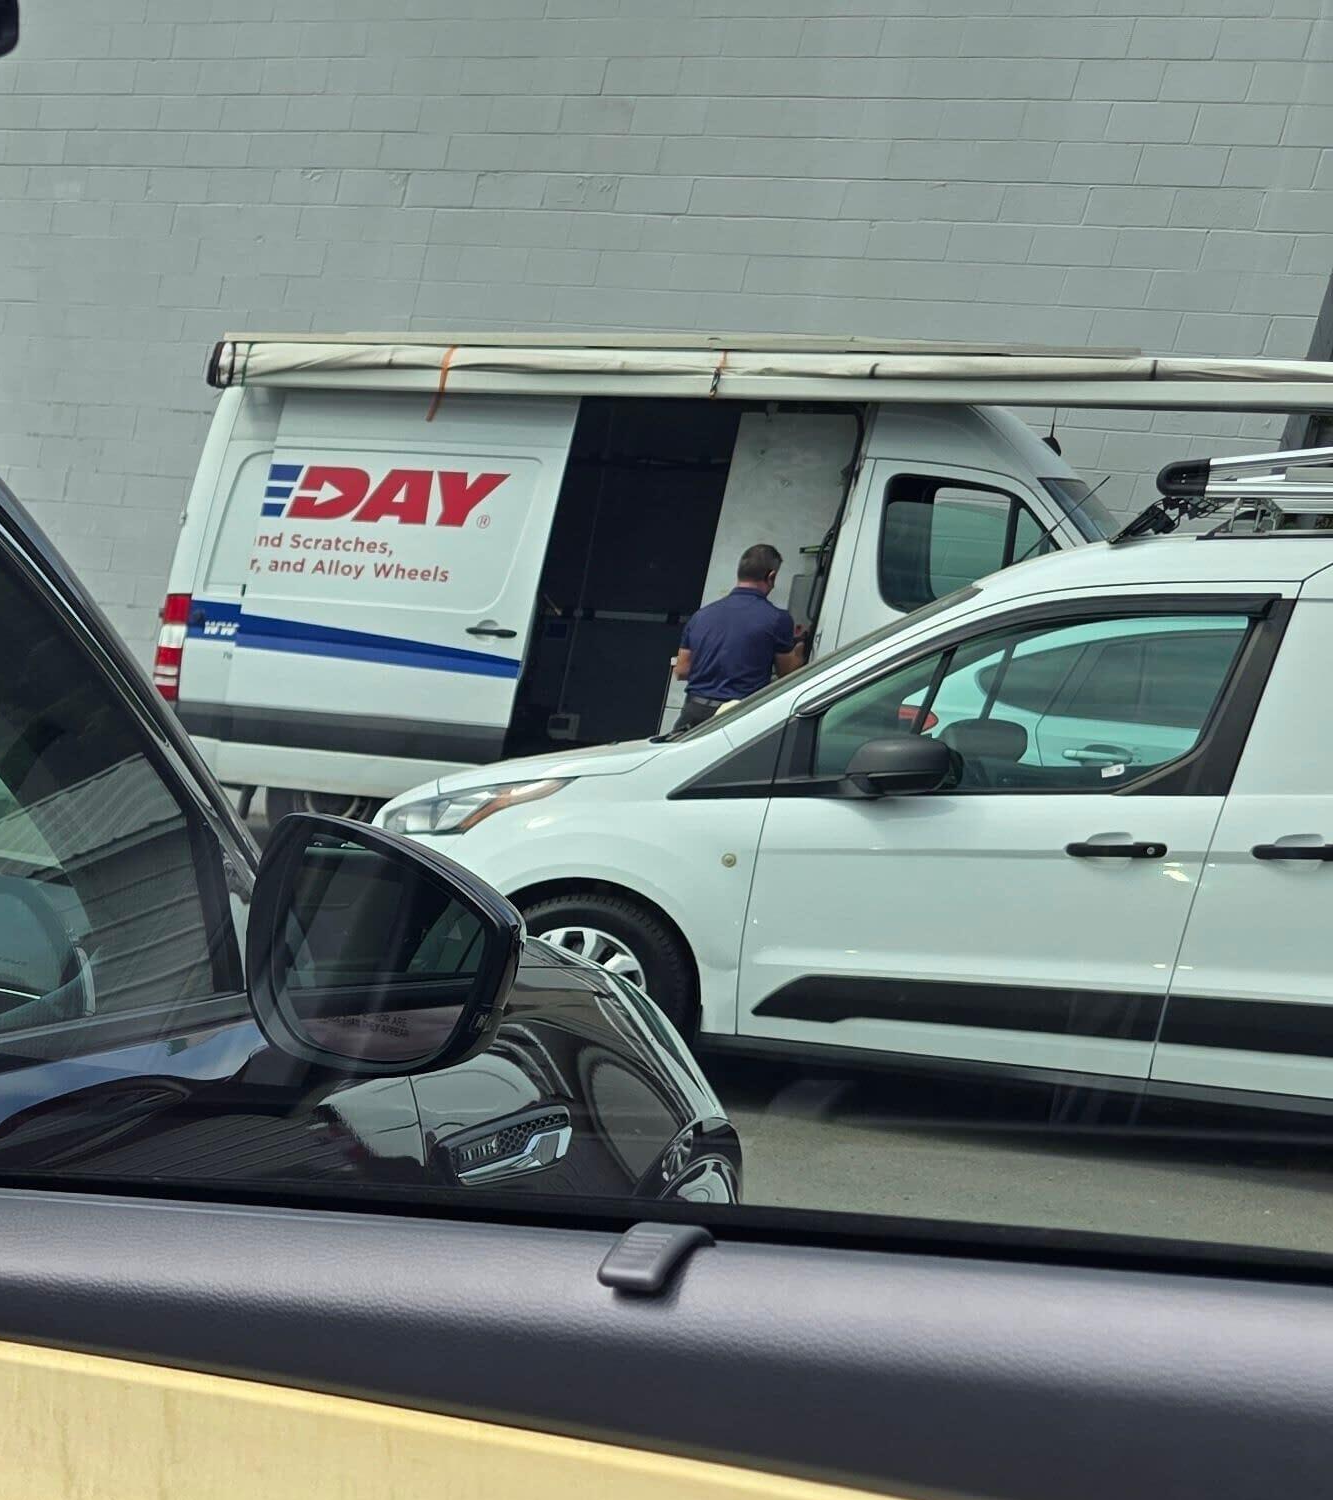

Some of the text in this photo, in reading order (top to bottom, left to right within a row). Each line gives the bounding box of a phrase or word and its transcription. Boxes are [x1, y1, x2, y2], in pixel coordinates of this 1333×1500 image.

[285, 466, 511, 527] DAY
[253, 532, 394, 558] nd Scratches,
[268, 557, 306, 574] and
[311, 559, 365, 580] Alloy
[373, 562, 450, 583] Wheels
